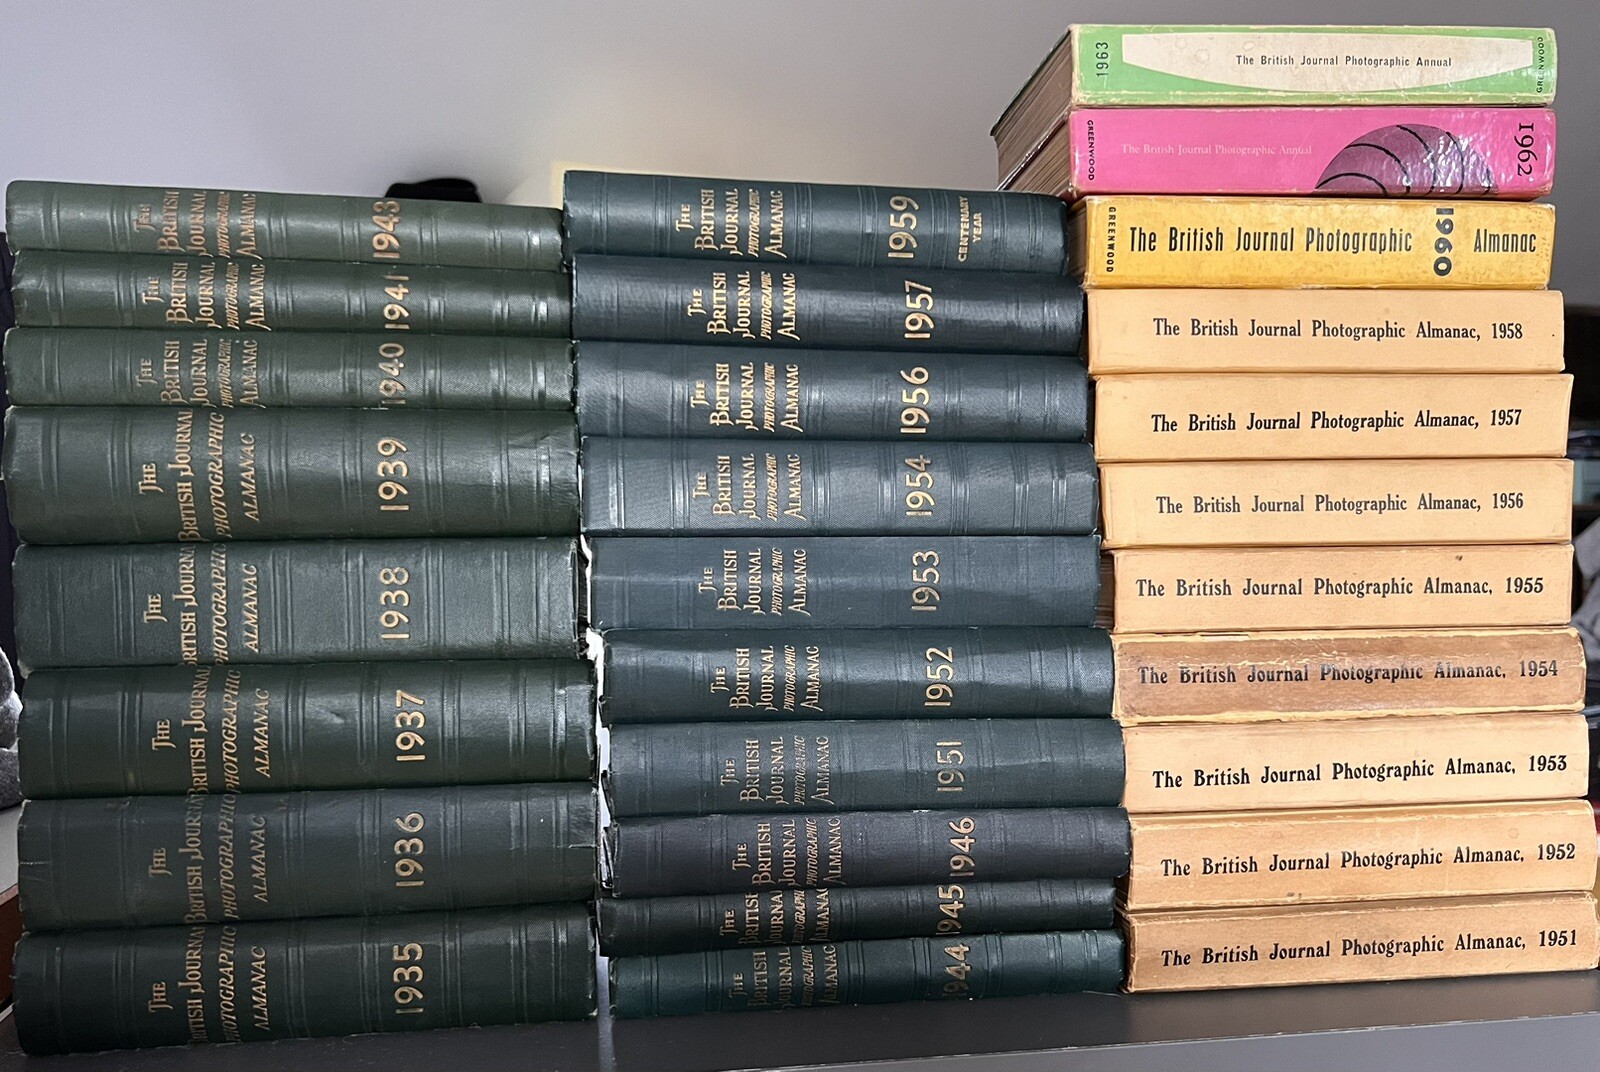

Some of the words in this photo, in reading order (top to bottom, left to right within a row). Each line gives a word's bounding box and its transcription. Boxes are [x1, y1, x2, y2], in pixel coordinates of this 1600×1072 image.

[1096, 40, 1108, 78] 1963
[1236, 54, 1255, 66] The
[1261, 55, 1295, 67] British
[1301, 55, 1338, 67] Journal
[1345, 55, 1410, 69] Photographic
[1416, 56, 1452, 67] Annual
[1536, 36, 1545, 93] GREENWOOD
[1087, 120, 1096, 181] GREENWOOD
[1122, 144, 1139, 155] The
[1143, 144, 1174, 155] British
[1178, 144, 1211, 155] Journal
[1215, 144, 1276, 157] Photographic
[1279, 145, 1312, 155] Annual
[1516, 122, 1535, 177] 1962
[372, 200, 401, 259] 1943
[888, 196, 919, 258] 1959
[958, 196, 969, 262] CENTENARY
[973, 212, 982, 243] YEAR
[1107, 206, 1115, 273] GREENWOOD
[1130, 227, 1156, 252] The
[1169, 227, 1224, 252] British
[1236, 227, 1294, 252] Journal
[1306, 227, 1412, 255] Photographic
[1474, 229, 1536, 252] Almanac
[384, 274, 410, 330] 1941
[904, 280, 934, 338] 1957
[1153, 318, 1180, 336] The
[1191, 319, 1238, 337] British
[1248, 319, 1301, 337] Journal
[1312, 320, 1405, 340] Photographic
[1416, 321, 1480, 341] Almanac,
[1491, 323, 1522, 340] 1958
[379, 342, 406, 405] 1940
[900, 366, 930, 434] 1956
[1152, 414, 1177, 432] The
[1188, 413, 1236, 431] British
[1246, 412, 1300, 430] Journal
[1310, 411, 1404, 432] Photographic
[1415, 410, 1479, 429] Almanac,
[1490, 409, 1521, 426] 1957
[378, 439, 409, 510] 1939
[905, 455, 934, 516] 1954
[1156, 497, 1183, 513] The
[1194, 496, 1240, 513] British
[1251, 495, 1304, 512] Journal
[1315, 494, 1406, 515] Photographic
[1417, 494, 1480, 512] Almanac,
[1492, 493, 1523, 509] 1956
[380, 566, 410, 640] 1938
[911, 550, 940, 611] 1953
[1136, 579, 1165, 596] The
[1176, 579, 1231, 596] British
[1242, 578, 1302, 596] Journal
[1313, 578, 1413, 599] Photographic
[1424, 577, 1492, 596] Almanac,
[1505, 577, 1544, 593] 1955
[925, 647, 954, 707] 1952
[1138, 666, 1167, 684] The
[1179, 665, 1236, 683] British
[1247, 664, 1309, 682] Journal
[1320, 663, 1423, 683] Photographic
[1519, 660, 1558, 677] 1954
[395, 690, 426, 761] 1937
[936, 741, 964, 792] 1951
[1153, 770, 1182, 789] The
[1193, 768, 1250, 787] British
[1261, 764, 1321, 784] Journal
[1332, 760, 1434, 781] Photographic
[1445, 757, 1516, 776] Almanac,
[1528, 755, 1567, 772] 1953
[394, 812, 424, 886] 1936
[949, 817, 975, 877] 1946
[1161, 858, 1190, 876] The
[1202, 856, 1258, 875] British
[1268, 853, 1329, 872] Journal
[1340, 849, 1442, 870] Photographic
[1453, 846, 1524, 864] Almanac,
[1537, 843, 1576, 860] 1952
[1162, 950, 1190, 967] The
[1202, 947, 1259, 965] British
[1269, 942, 1330, 960] Journal
[1341, 937, 1444, 957] Photographic
[1454, 933, 1526, 951] Almanac,
[1538, 930, 1577, 948] 1951
[392, 942, 424, 1014] 1935
